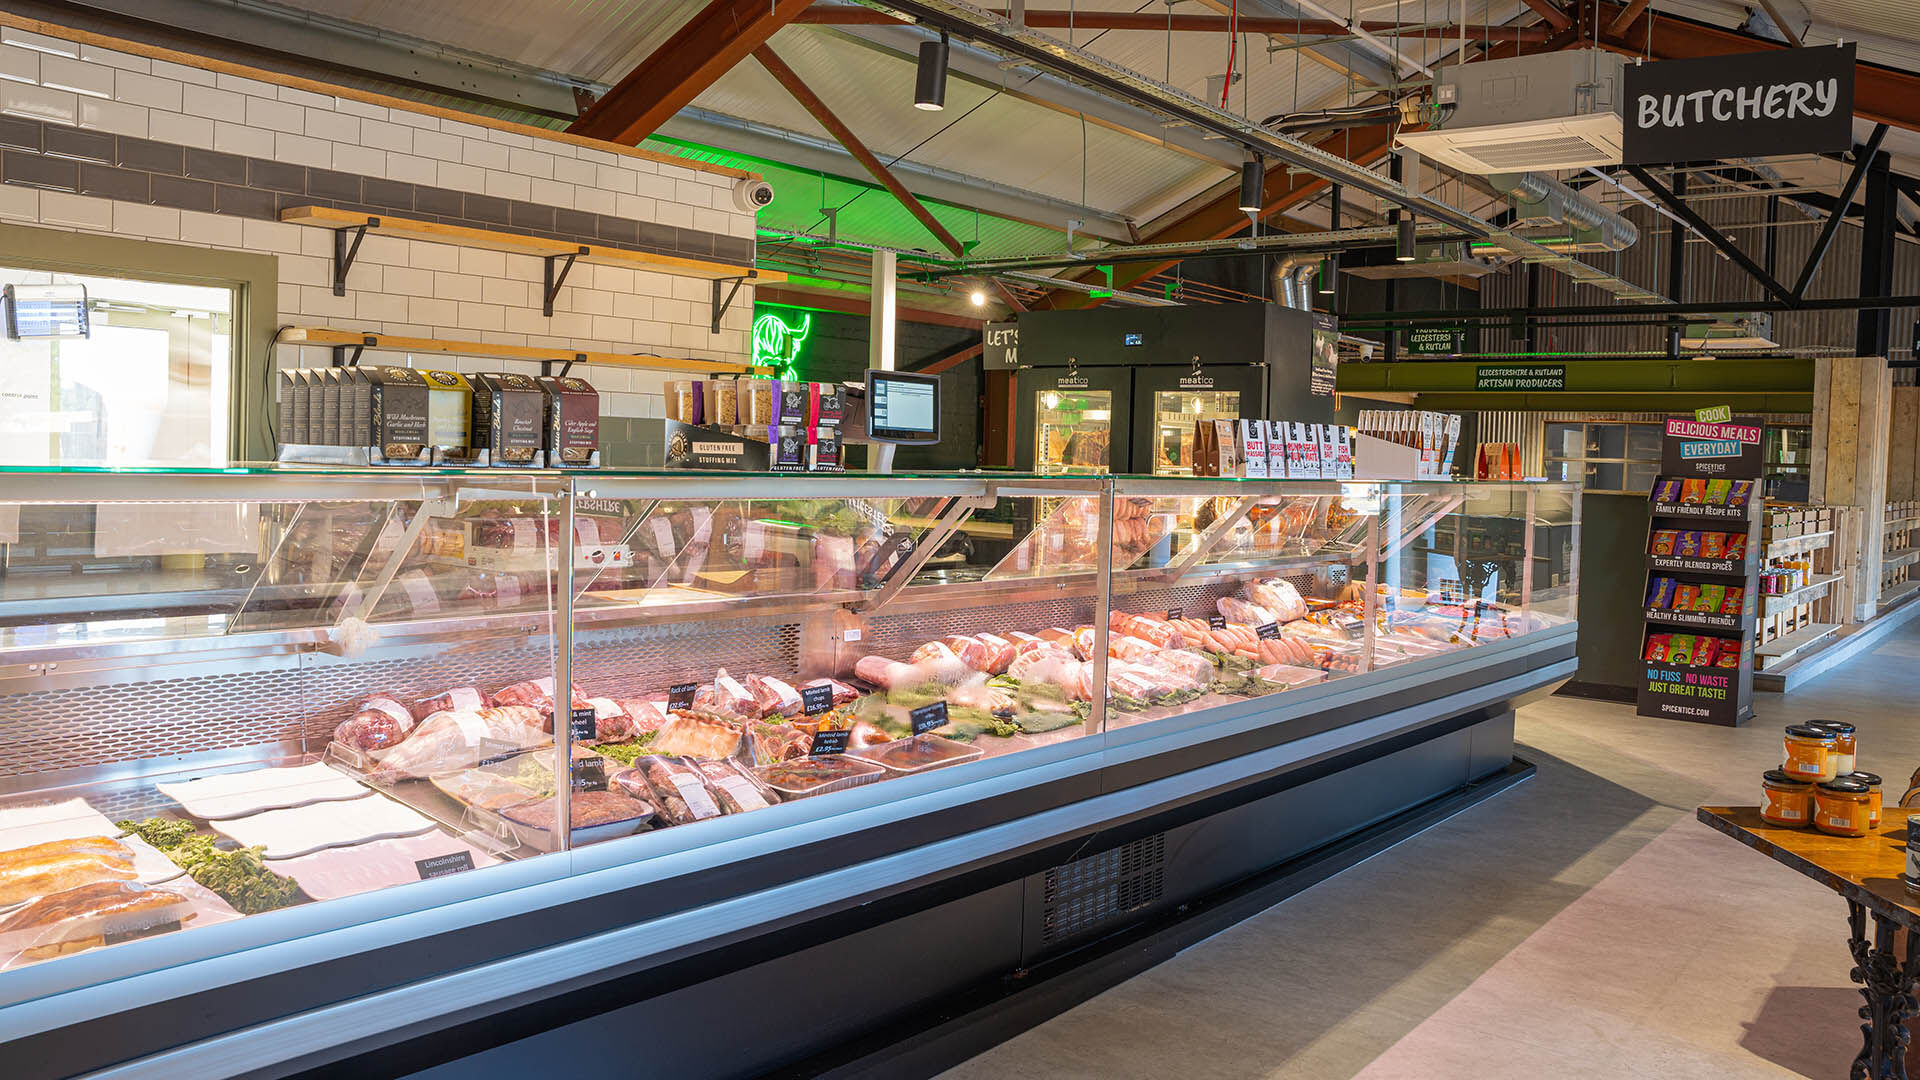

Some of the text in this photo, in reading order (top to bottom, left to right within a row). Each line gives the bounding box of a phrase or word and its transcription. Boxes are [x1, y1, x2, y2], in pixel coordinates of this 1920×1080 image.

[1638, 78, 1838, 129] BUTCHERY
[1425, 343, 1451, 351] RUTLAN
[1534, 368, 1563, 376] RUTLAND
[1058, 376, 1089, 384] meatico
[1180, 376, 1214, 384] meatico
[1478, 379, 1563, 388] ARTISAN PRODUCERS
[1699, 408, 1727, 422] COOK
[1669, 421, 1757, 441] DELICIOUS MEALS
[1246, 441, 1263, 450] BUTT
[1302, 443, 1317, 452] STEAK
[1338, 445, 1349, 454] FISH
[1684, 441, 1737, 456] EVERYDAY
[1305, 453, 1318, 461] MATE
[1655, 505, 1741, 517] FAMILY FRIENDLY RECIPE KITS
[1655, 559, 1733, 571] EXPERTLY BLENDED SPICES
[1646, 611, 1736, 626] HEALTHY & SLIMMING FRIENDLY
[1648, 668, 1729, 688] NO FUSS NO WASTE
[1648, 681, 1727, 700] JUST GREAT TASTE!
[1661, 704, 1710, 717] SPICENTICE.COM
[585, 759, 604, 767] lamb
[424, 854, 466, 868] Lincolnshire
